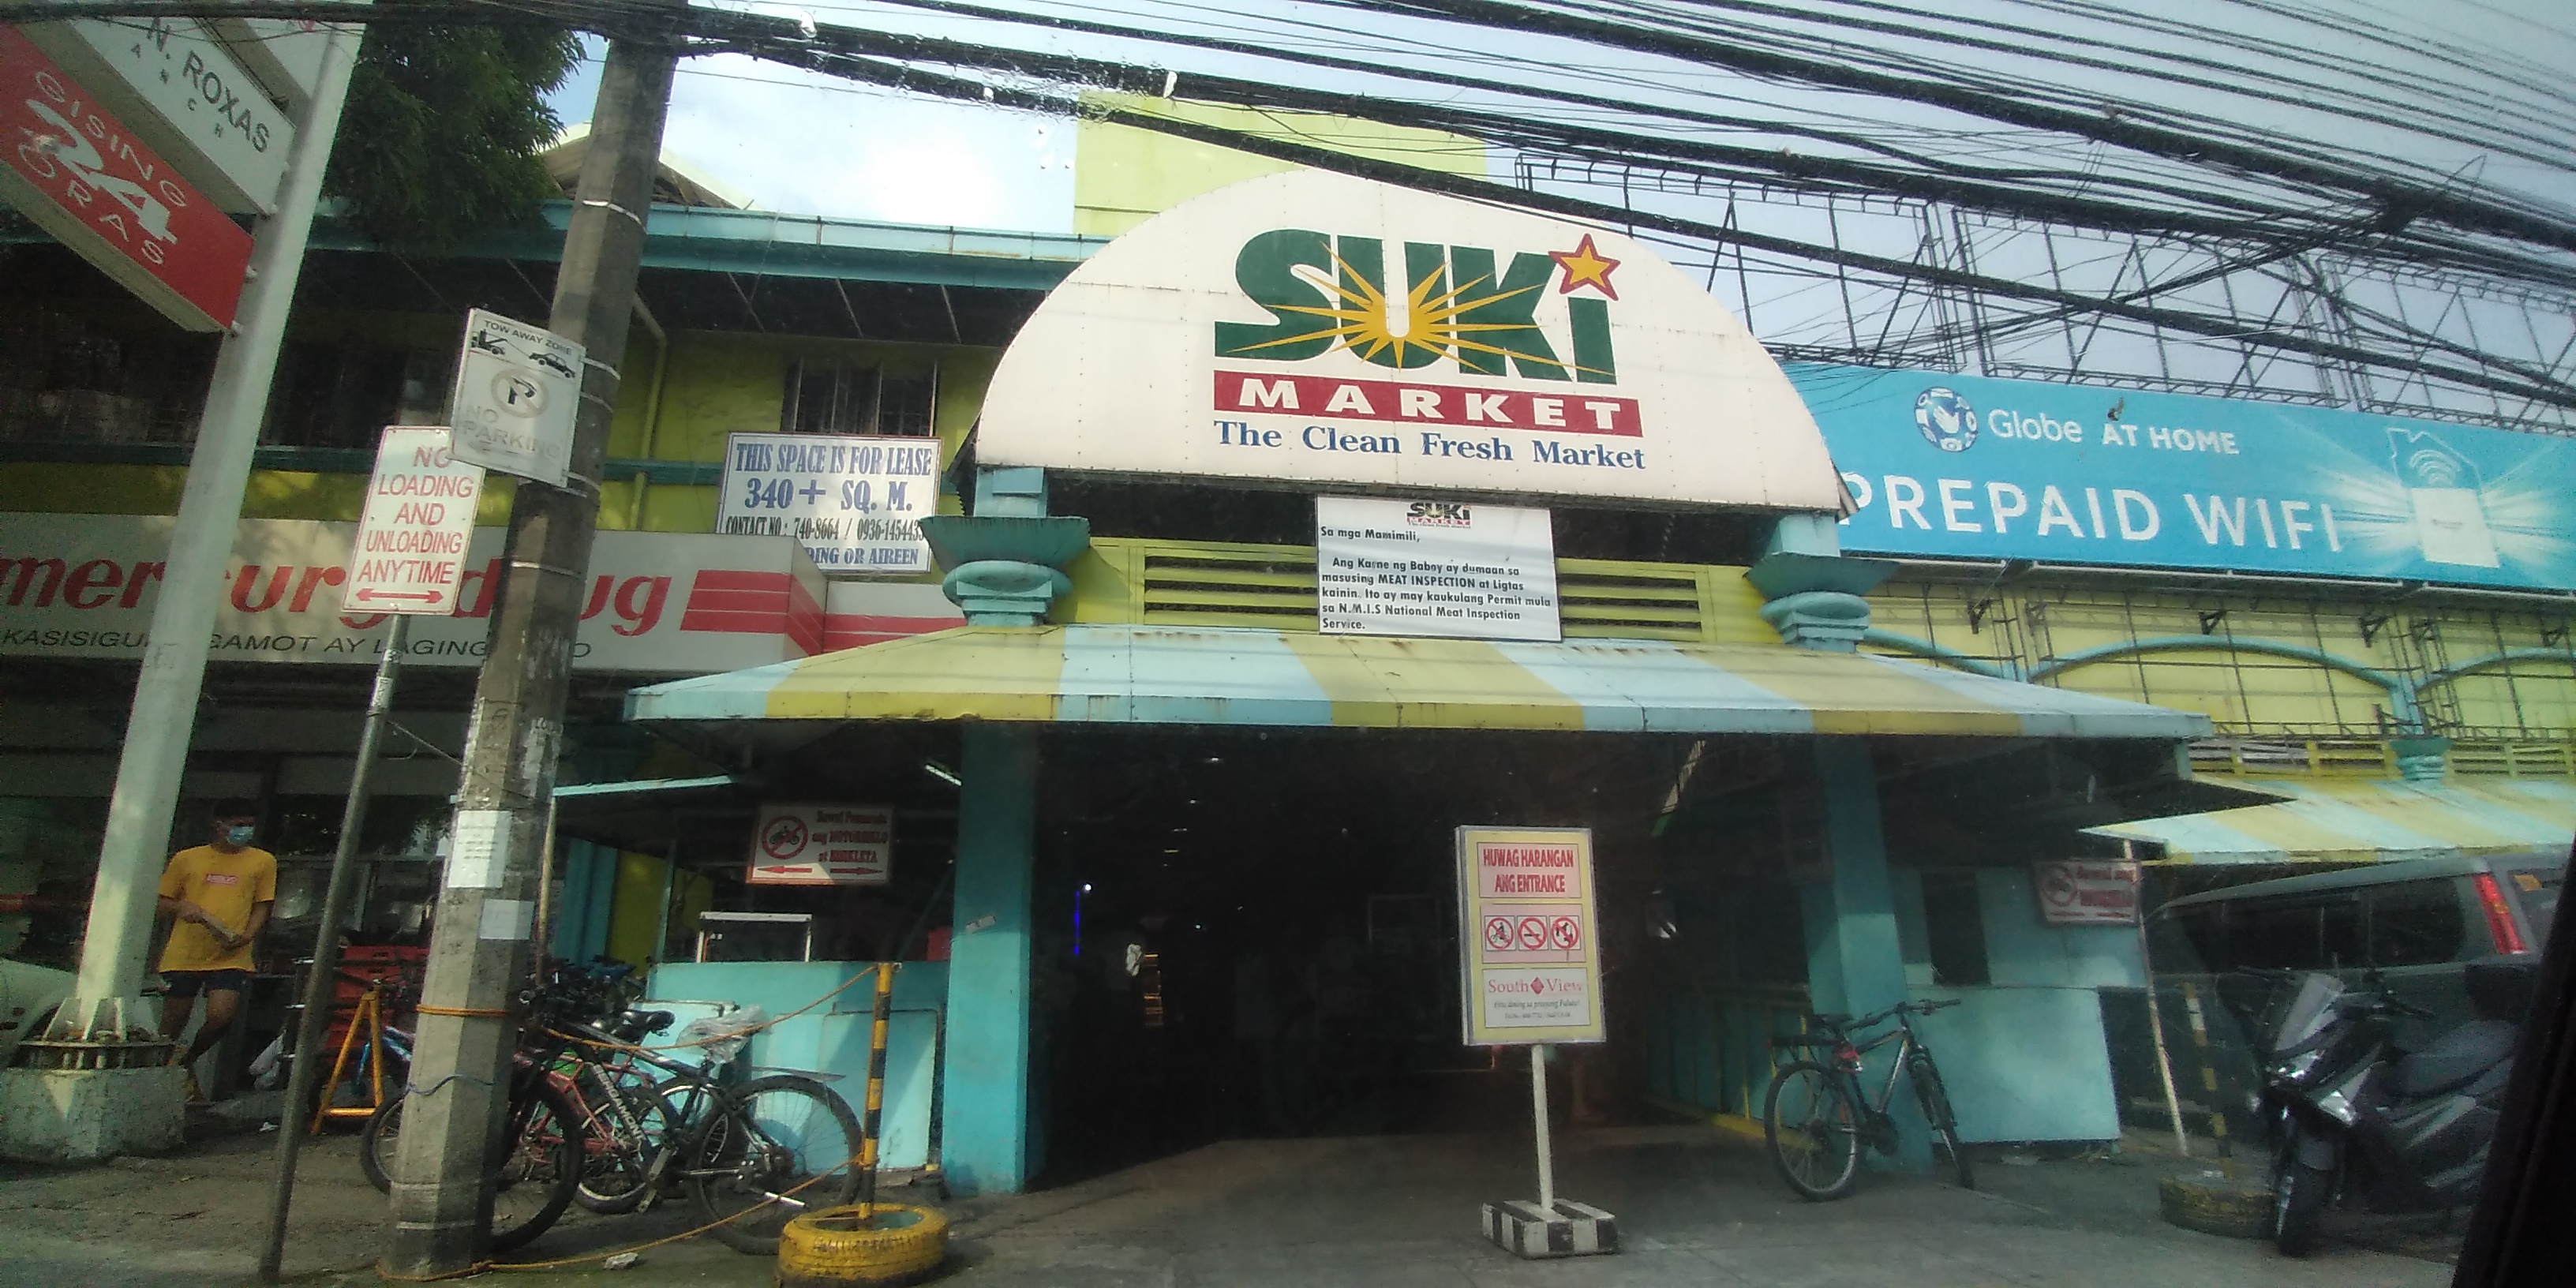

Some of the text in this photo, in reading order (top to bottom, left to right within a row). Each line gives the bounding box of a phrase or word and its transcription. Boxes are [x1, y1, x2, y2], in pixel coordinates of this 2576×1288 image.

[182, 51, 270, 153] ROXAS
[35, 71, 187, 208] GISING
[19, 99, 178, 245] 24
[18, 143, 164, 265] ORAS
[484, 320, 574, 356] TOW AWAY ZONE
[463, 403, 499, 423] NO
[1237, 377, 1621, 431] MARKET
[462, 419, 561, 459] PARKING
[1987, 408, 2241, 455] Globe AT HOME
[1214, 419, 1646, 470] The Clean Fresh Market
[413, 446, 453, 469] NO
[735, 443, 933, 476] THIS SPACE IS FOR LEASE
[377, 474, 474, 497] LOADING
[744, 477, 795, 509] 340
[841, 480, 878, 514] SQ.
[886, 481, 912, 511] M.
[393, 502, 446, 525] AND
[1839, 471, 2342, 552] PREPAID WIFI
[725, 515, 768, 536] CONTACT
[794, 517, 840, 540] 740-8664
[1320, 526, 1421, 542] Sa mga Mamimili,
[365, 530, 462, 553] UNLOADING
[844, 547, 866, 564] OR
[869, 548, 919, 565] AIREEN
[1332, 557, 1520, 576] Ang Karne ng Baboy ay dumaan sa
[357, 560, 456, 584] ANYTIME
[1321, 572, 1524, 592] masusing MEAT INSPECTION at Ligtas
[0, 556, 672, 637] merur dg
[1365, 588, 1380, 599] Ito
[1383, 591, 1397, 602] ay
[1399, 592, 1423, 603] may
[1427, 590, 1484, 605] kaukulang
[1487, 593, 1522, 606] Permit
[1525, 596, 1552, 607] mula
[1321, 602, 1521, 621] sa N.M.I.S National Meat Inspection
[1322, 617, 1365, 630] Service.
[2, 629, 149, 649] KASISIGU
[324, 637, 366, 653] AY
[373, 638, 488, 657] LGING
[1482, 848, 1574, 868] HUWAG HARANGAN
[1494, 873, 1566, 893] ANG ENTRANCE
[1488, 977, 1583, 993] South View
